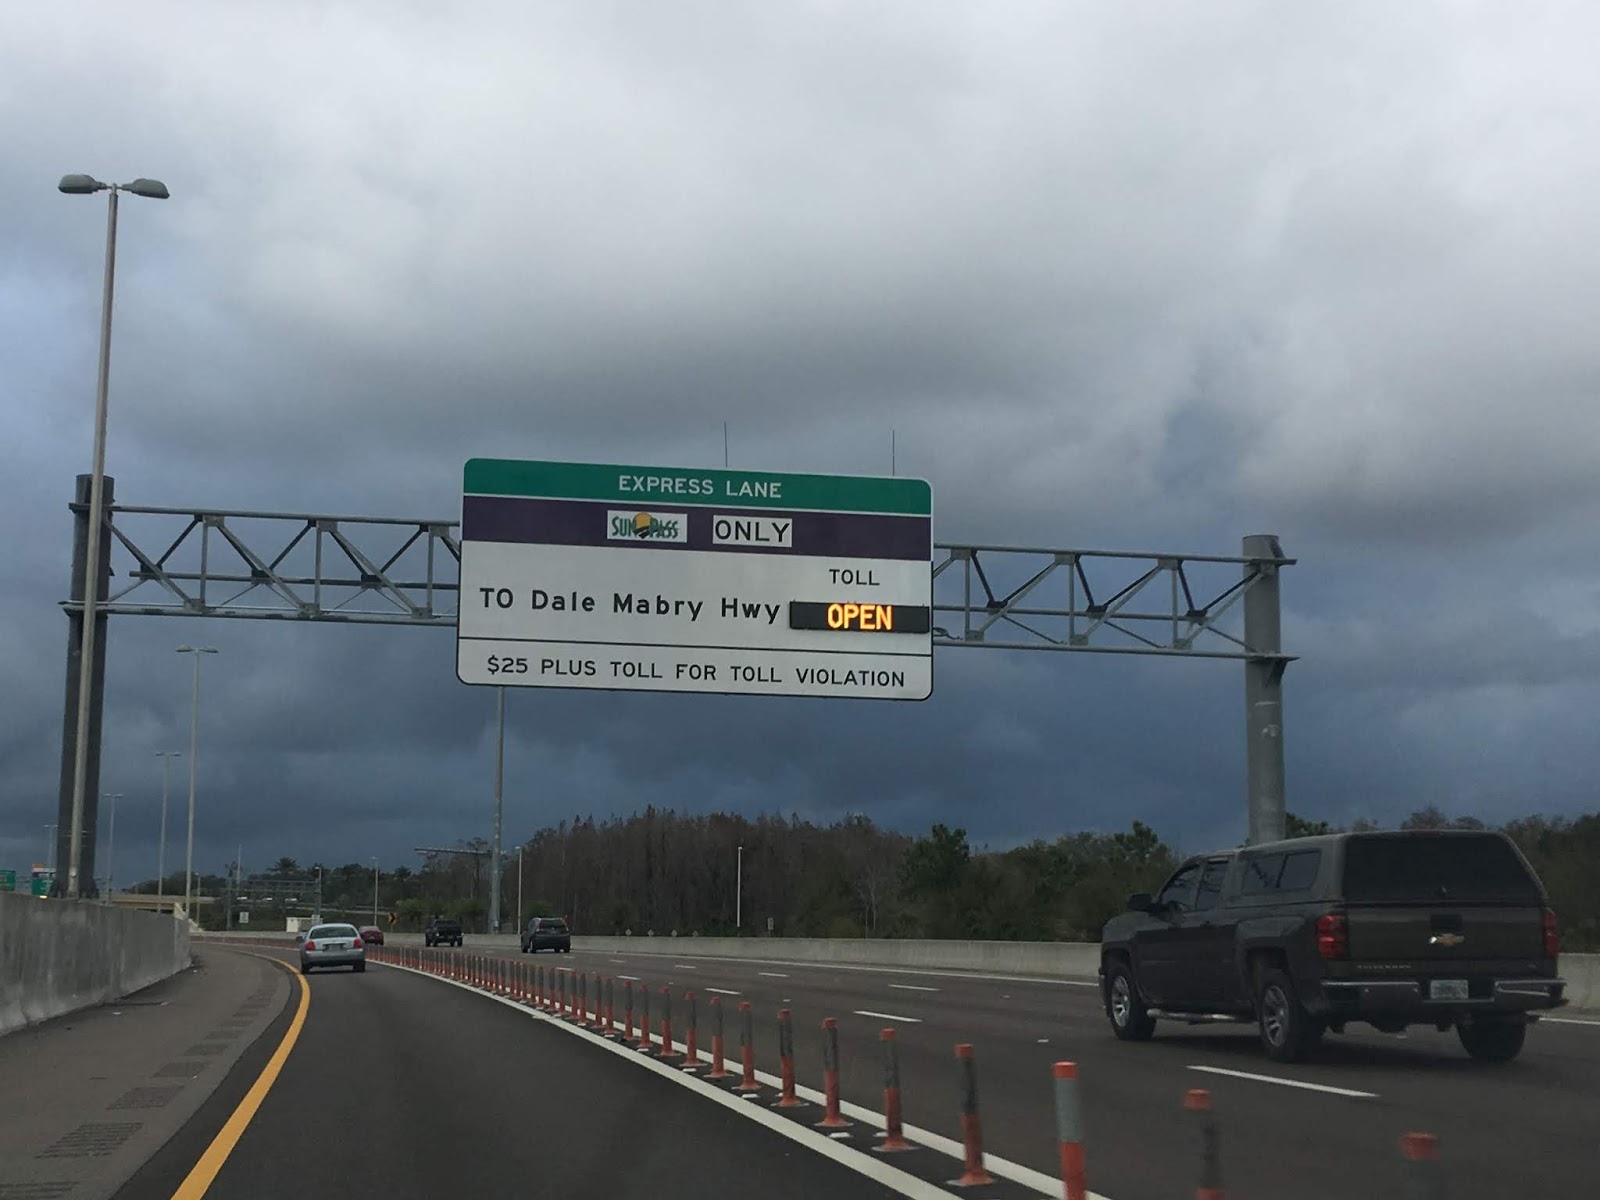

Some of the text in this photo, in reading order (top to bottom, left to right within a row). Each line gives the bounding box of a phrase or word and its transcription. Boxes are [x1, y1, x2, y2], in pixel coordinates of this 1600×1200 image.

[619, 475, 781, 498] EXPRESS LANE
[715, 519, 790, 543] ONLY
[829, 569, 880, 586] TOLL
[480, 587, 780, 624] TO Dale Mabry Hwy
[827, 603, 893, 631] OPEN
[487, 654, 905, 687] $25 PLUS TOLL FOR TOLL VIOLATION
